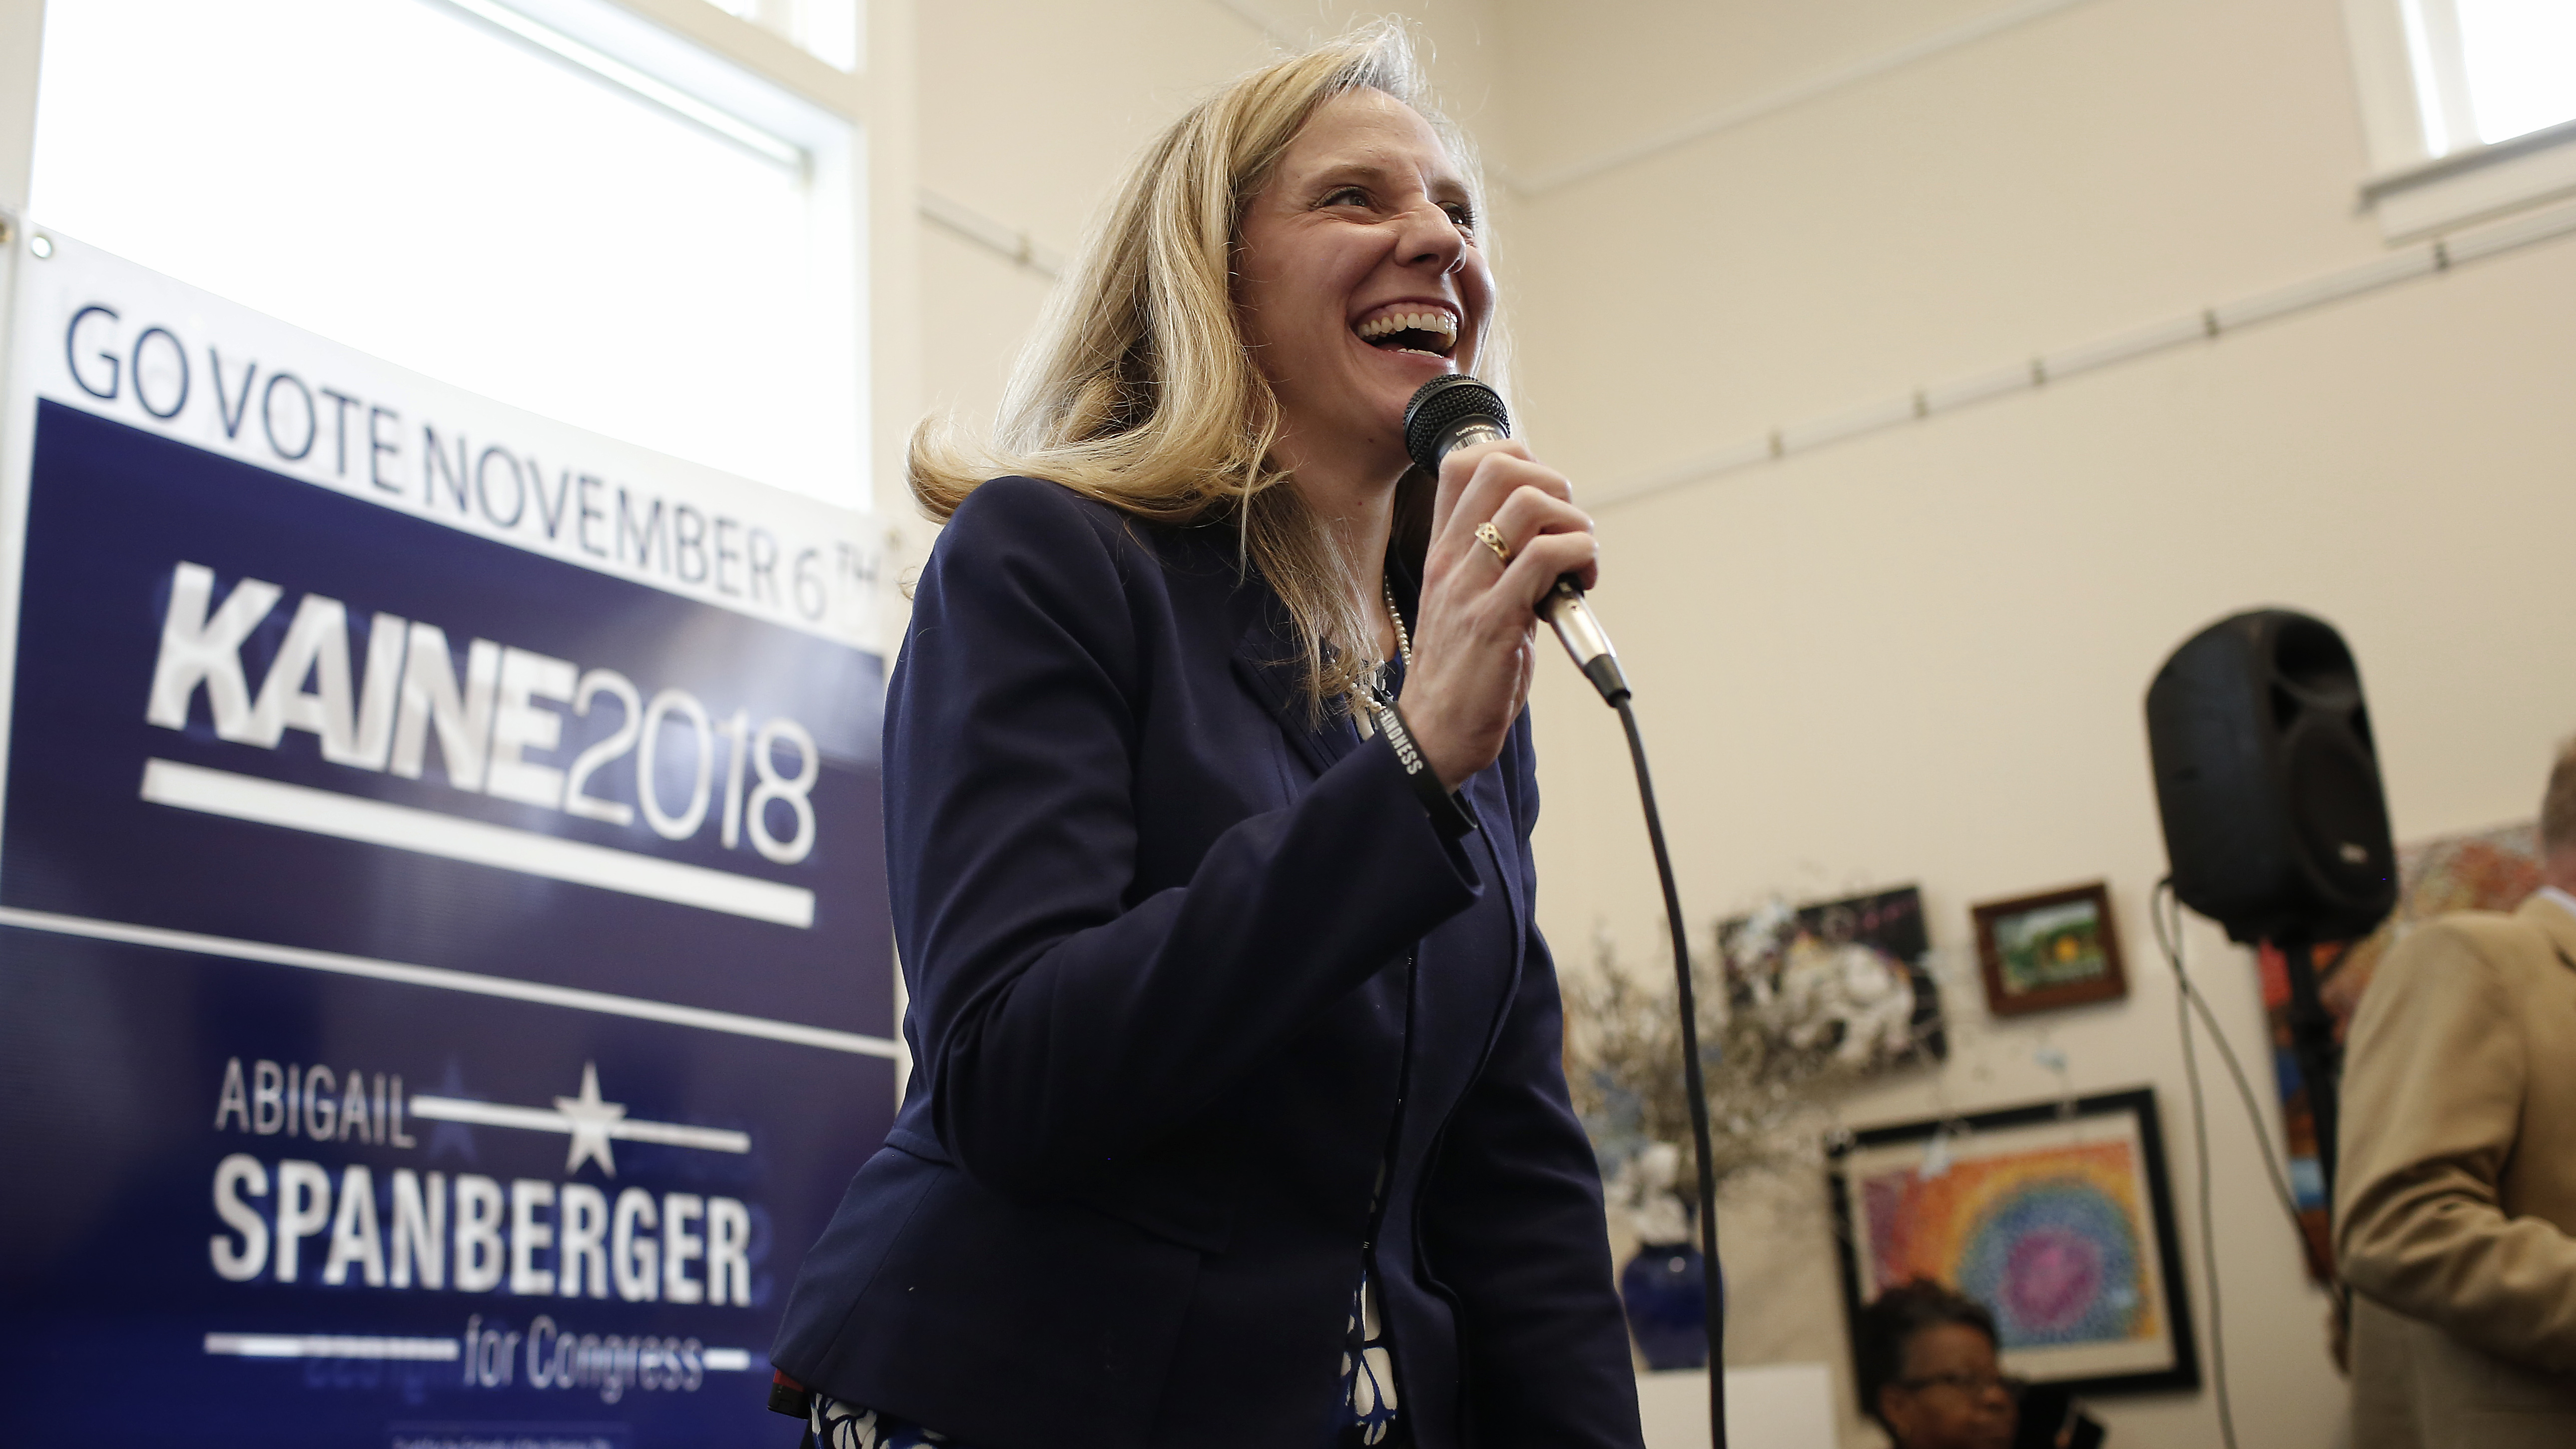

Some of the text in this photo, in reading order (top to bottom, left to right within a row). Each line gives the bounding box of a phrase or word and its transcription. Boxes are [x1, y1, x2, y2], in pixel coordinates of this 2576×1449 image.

[65, 302, 189, 419] GO
[208, 345, 404, 494] VOTE
[424, 423, 780, 608] NOVEMBER
[214, 1056, 416, 1149] ABIGAIL
[208, 1153, 752, 1307] SPANBERGER
[463, 1313, 521, 1387] for
[526, 1314, 704, 1405] Congress
